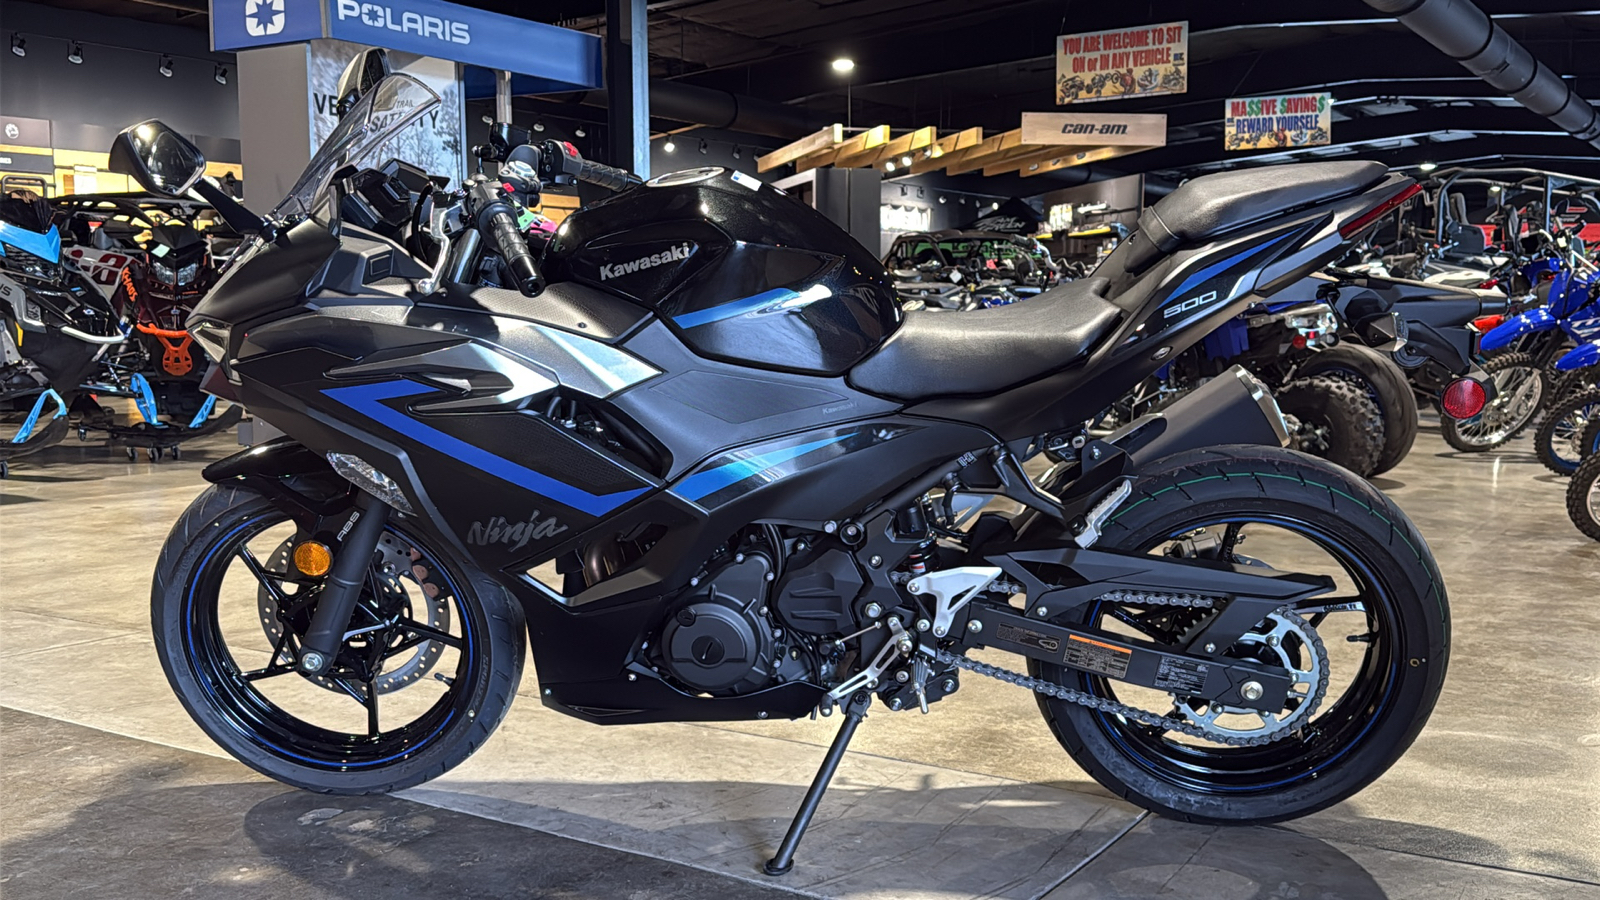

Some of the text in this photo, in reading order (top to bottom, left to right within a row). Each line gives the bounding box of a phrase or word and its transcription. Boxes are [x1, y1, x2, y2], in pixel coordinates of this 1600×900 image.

[337, 0, 471, 45] POLARIS
[1063, 26, 1183, 55] YOU ARE WELCOME TO SIT
[1072, 55, 1085, 73] ON
[1087, 57, 1099, 72] or
[1100, 53, 1110, 71] IN
[1111, 51, 1131, 69] ANY
[1132, 47, 1172, 67] VEHICLE
[1279, 95, 1326, 115] $AVING$
[1061, 123, 1128, 134] can-am
[1236, 116, 1274, 134] REWARD
[1276, 114, 1320, 132] YOURSELF
[599, 242, 690, 281] Kawasaki
[120, 266, 138, 302] KHAOS
[1164, 290, 1217, 319] 500
[822, 402, 858, 414] Kawasaki
[336, 511, 360, 542] ABS
[467, 509, 569, 553] Ninja
